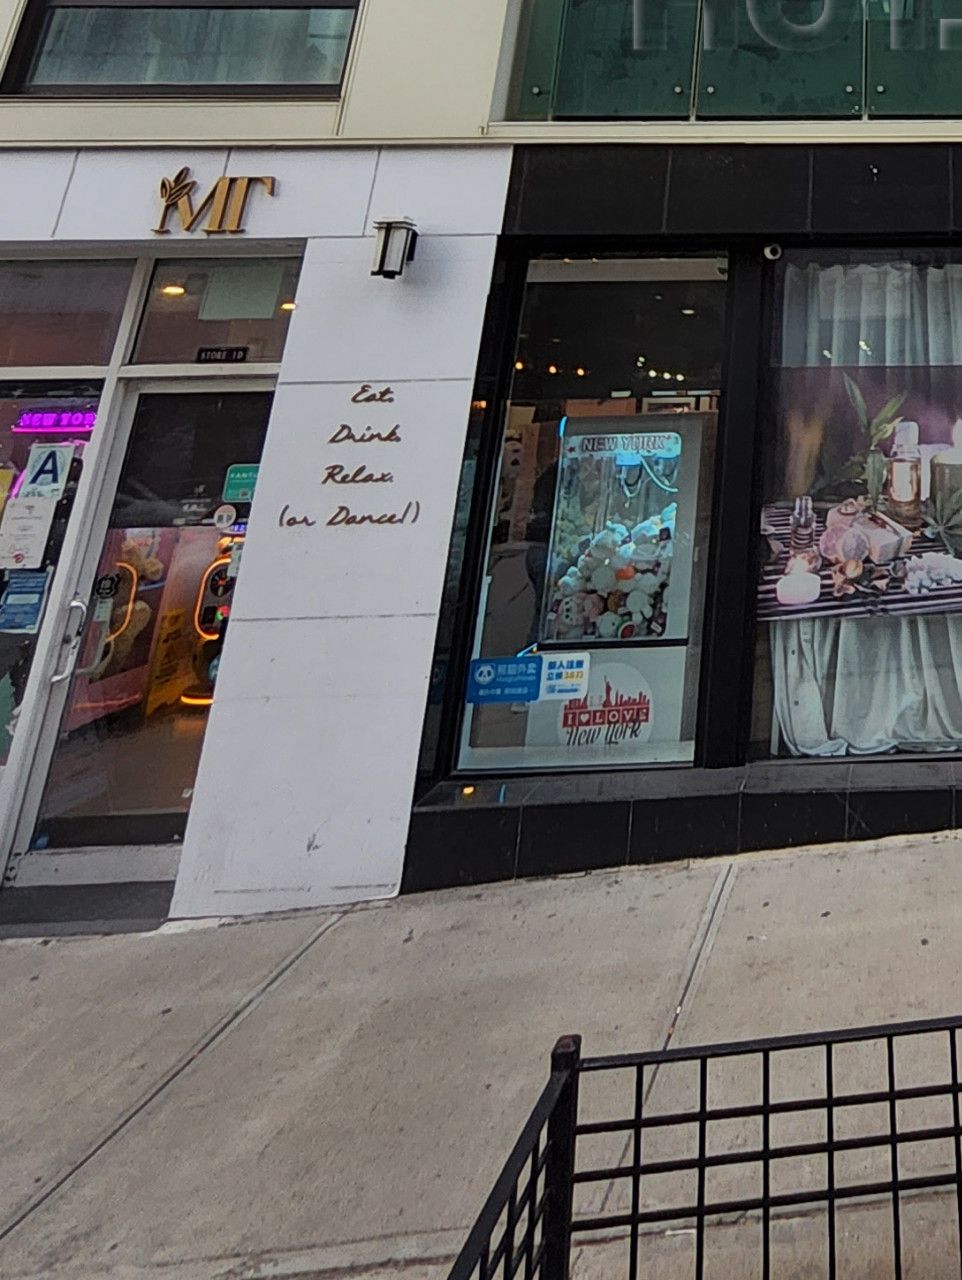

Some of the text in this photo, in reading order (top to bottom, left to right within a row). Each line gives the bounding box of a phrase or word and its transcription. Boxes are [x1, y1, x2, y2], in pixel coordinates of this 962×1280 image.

[20, 412, 58, 426] NEW
[581, 436, 618, 452] NEW
[29, 449, 60, 485] A
[279, 504, 317, 527] (or
[594, 708, 648, 723] LOVE
